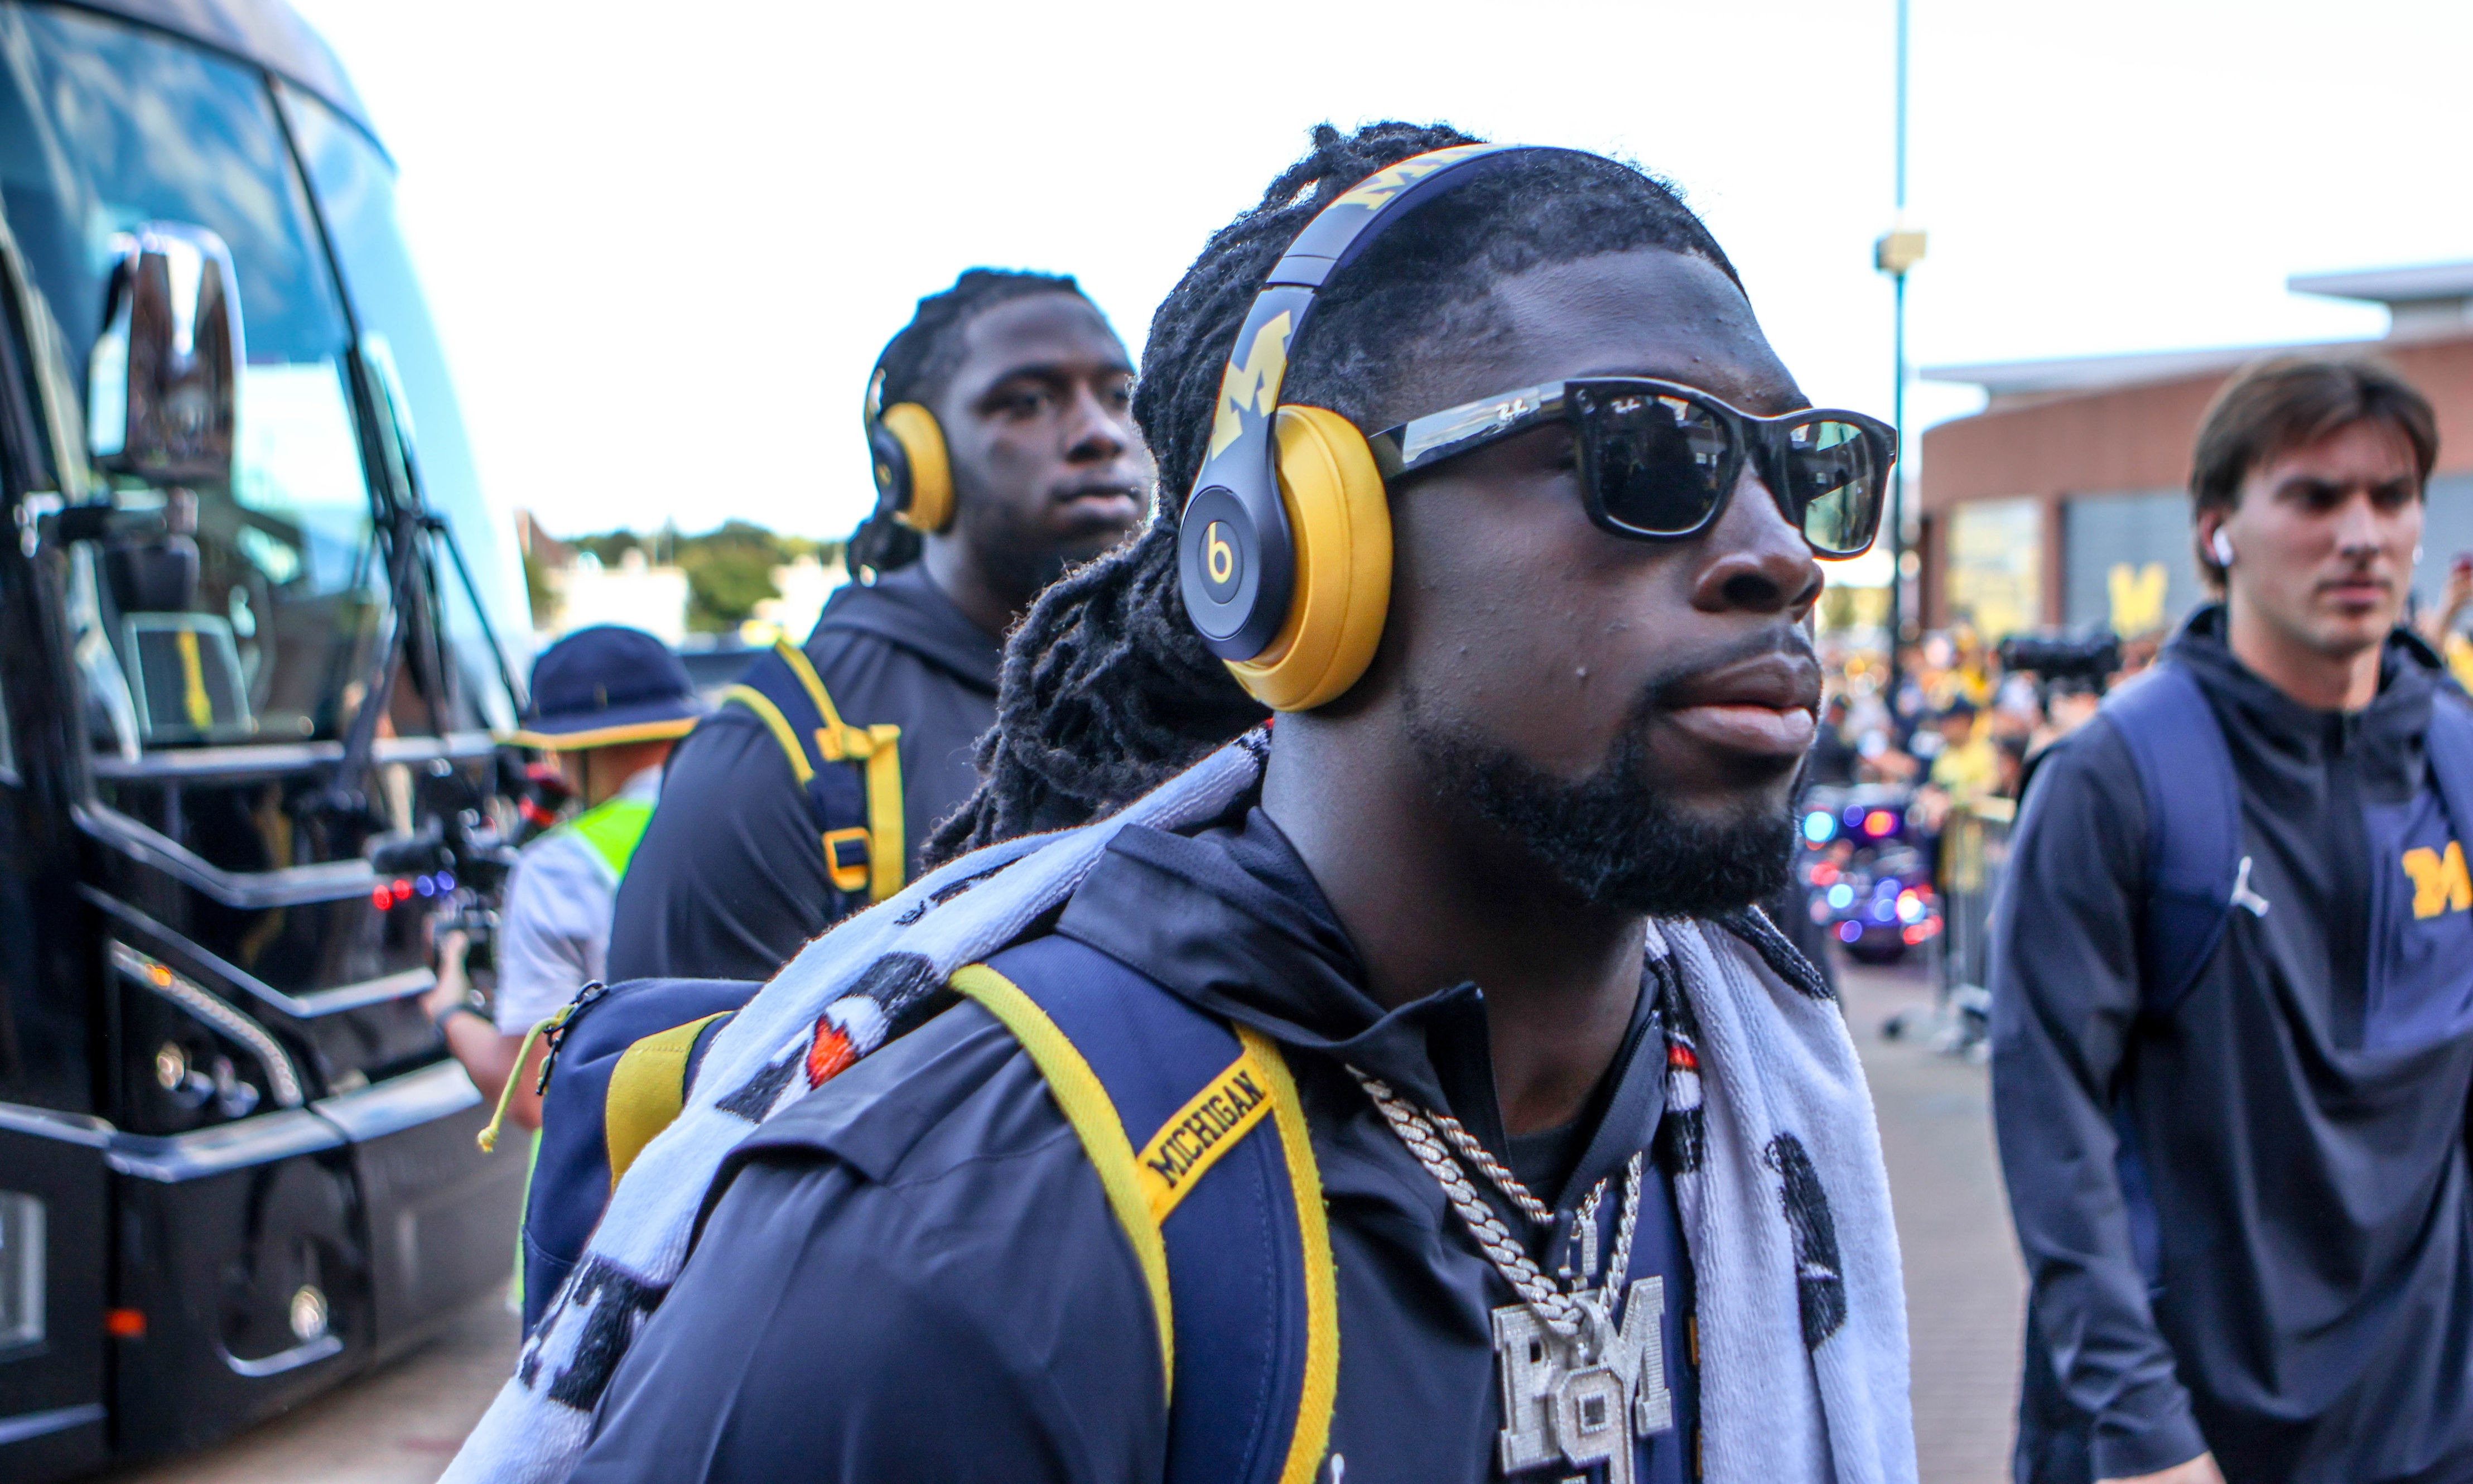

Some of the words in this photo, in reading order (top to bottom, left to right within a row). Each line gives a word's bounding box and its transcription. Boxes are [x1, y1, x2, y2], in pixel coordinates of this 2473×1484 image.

[1211, 310, 1291, 461] M
[1207, 521, 1233, 584] b
[2401, 839, 2473, 920] M
[1147, 1069, 1266, 1189] MICHIGAN
